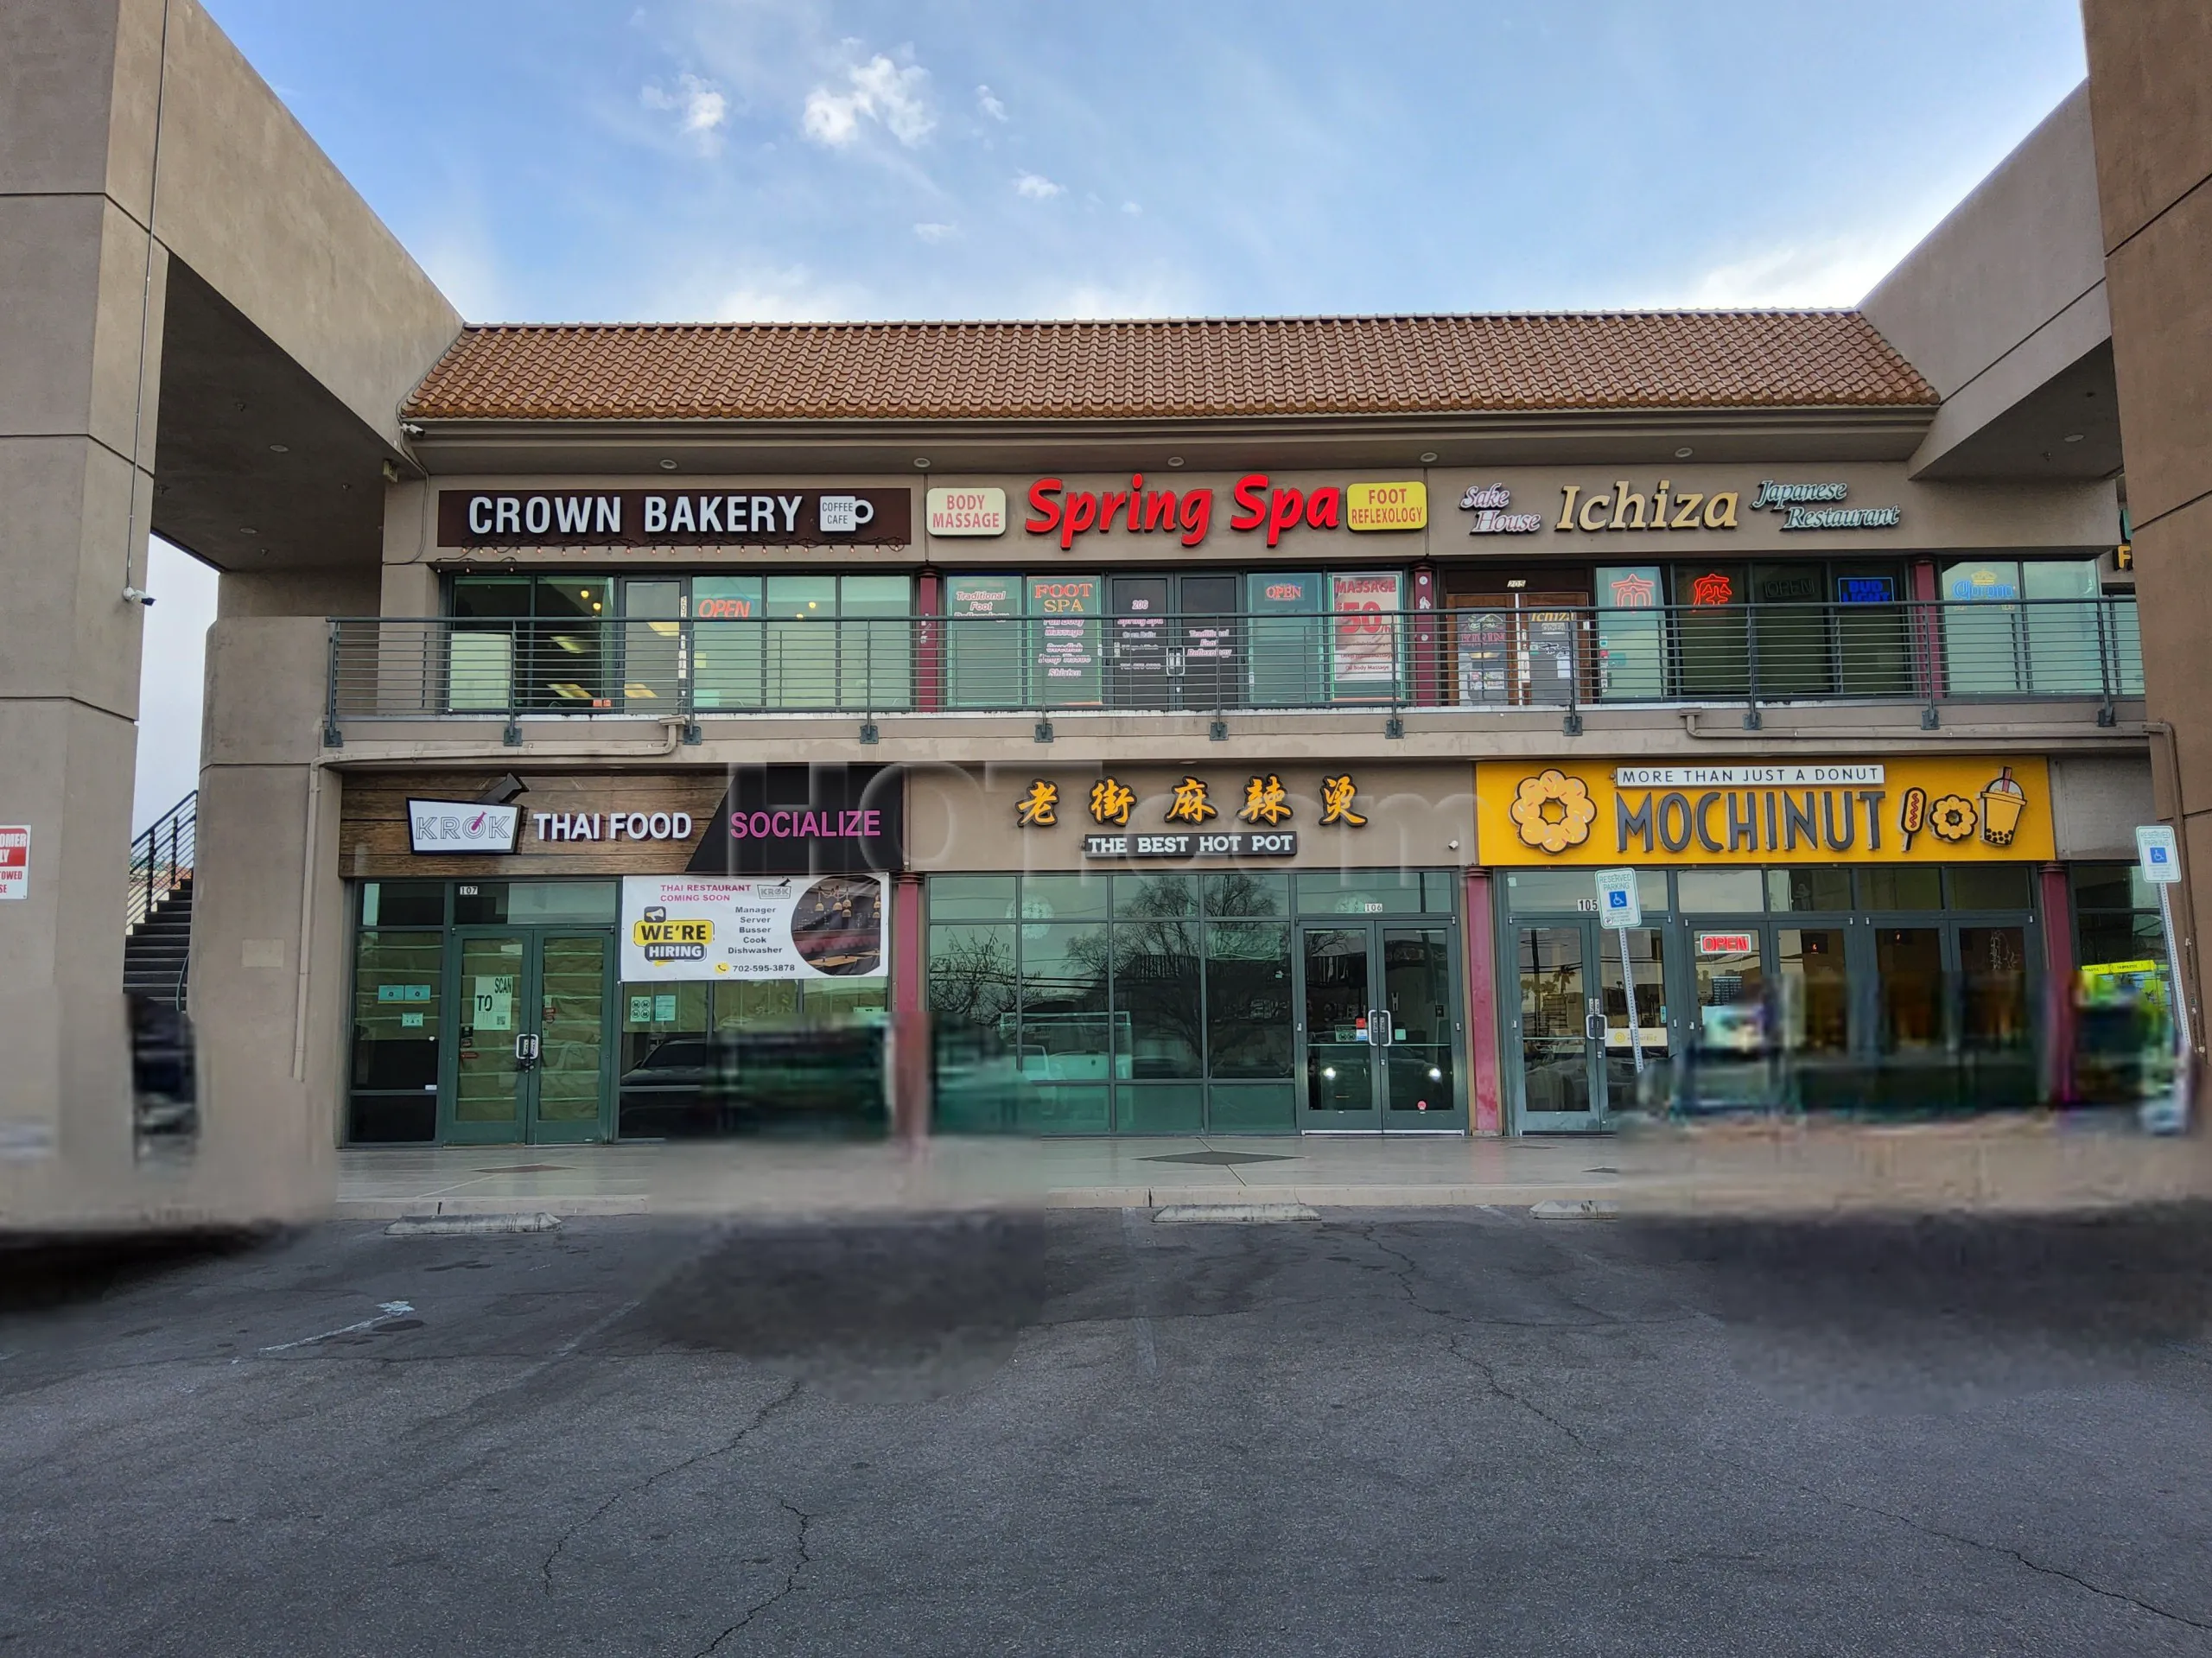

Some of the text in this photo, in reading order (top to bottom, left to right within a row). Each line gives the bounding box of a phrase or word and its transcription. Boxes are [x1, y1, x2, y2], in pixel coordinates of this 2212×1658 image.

[946, 494, 985, 511] BODY
[1369, 488, 1407, 505] FOOT
[1459, 482, 1510, 510] Sake
[1751, 480, 1848, 511] Japanese
[822, 502, 854, 512] COFFEE
[1025, 473, 1341, 549] Spring Spa
[1555, 479, 1738, 531] Ichiza
[468, 495, 803, 534] CROWN BAKERY
[827, 514, 849, 524] CAFE
[932, 512, 1000, 528] MASSAGE
[1351, 506, 1423, 525] REFLEXOLOGY
[1471, 509, 1541, 534] House
[1783, 504, 1901, 530] Restaurant
[1034, 583, 1093, 599] FOOT
[1266, 585, 1302, 600] OPEN
[1334, 580, 1396, 594] MASSAGE
[1768, 579, 1813, 596] OPEN
[1848, 581, 1883, 593] BUD
[1952, 580, 2013, 601] Corona
[957, 591, 1007, 600] Traditional
[698, 599, 751, 619] OPEN
[969, 601, 994, 612] Foot
[1044, 599, 1084, 613] SPA
[1132, 600, 1148, 610] 206
[1045, 626, 1084, 638] Massage
[1622, 767, 1878, 784] MORE THAN JUST A DONUT
[1015, 774, 1368, 827] 老街麻辣烫
[533, 812, 692, 841] THAI FOOD
[730, 809, 881, 839] SOCIALIZE
[1616, 791, 1886, 853] MOCHINUT
[1087, 835, 1294, 854] THE BEST HOT POT
[1599, 873, 1632, 884] RESERVED
[1603, 881, 1630, 891] PARKING
[735, 906, 777, 915] Manager
[1579, 899, 1598, 911] 105
[743, 936, 767, 944] Cook
[1702, 936, 1749, 951] OPEN
[649, 945, 702, 958] HIRING
[728, 946, 783, 955] Dishwasher
[733, 963, 795, 973] 702-595-3878
[494, 977, 512, 994] SCAN
[476, 994, 493, 1012] TO
